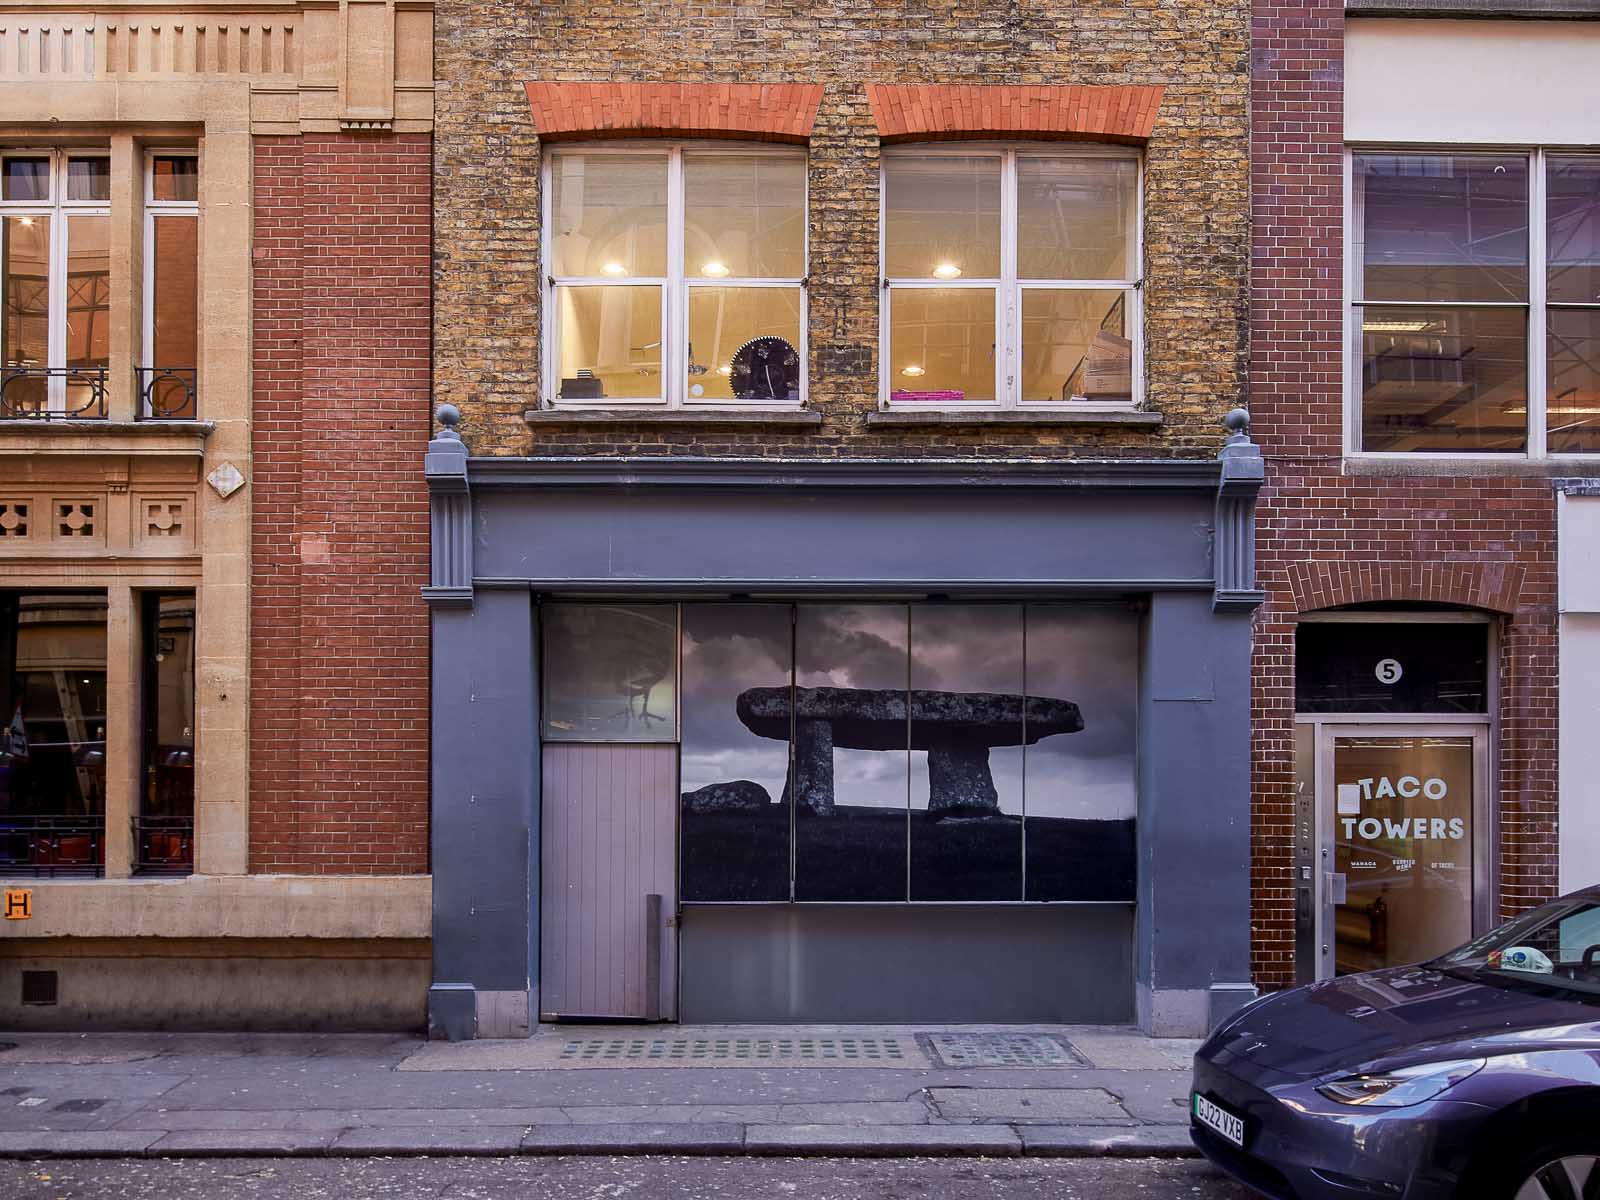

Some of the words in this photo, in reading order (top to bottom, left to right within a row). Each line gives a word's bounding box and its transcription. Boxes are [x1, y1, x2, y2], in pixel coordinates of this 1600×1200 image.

[1382, 663, 1396, 680] 5
[1358, 776, 1448, 801] TACO
[1340, 817, 1465, 841] TOWERS
[8, 893, 28, 916] H
[1199, 1098, 1221, 1129] GJ22
[1222, 1111, 1242, 1141] VXB
